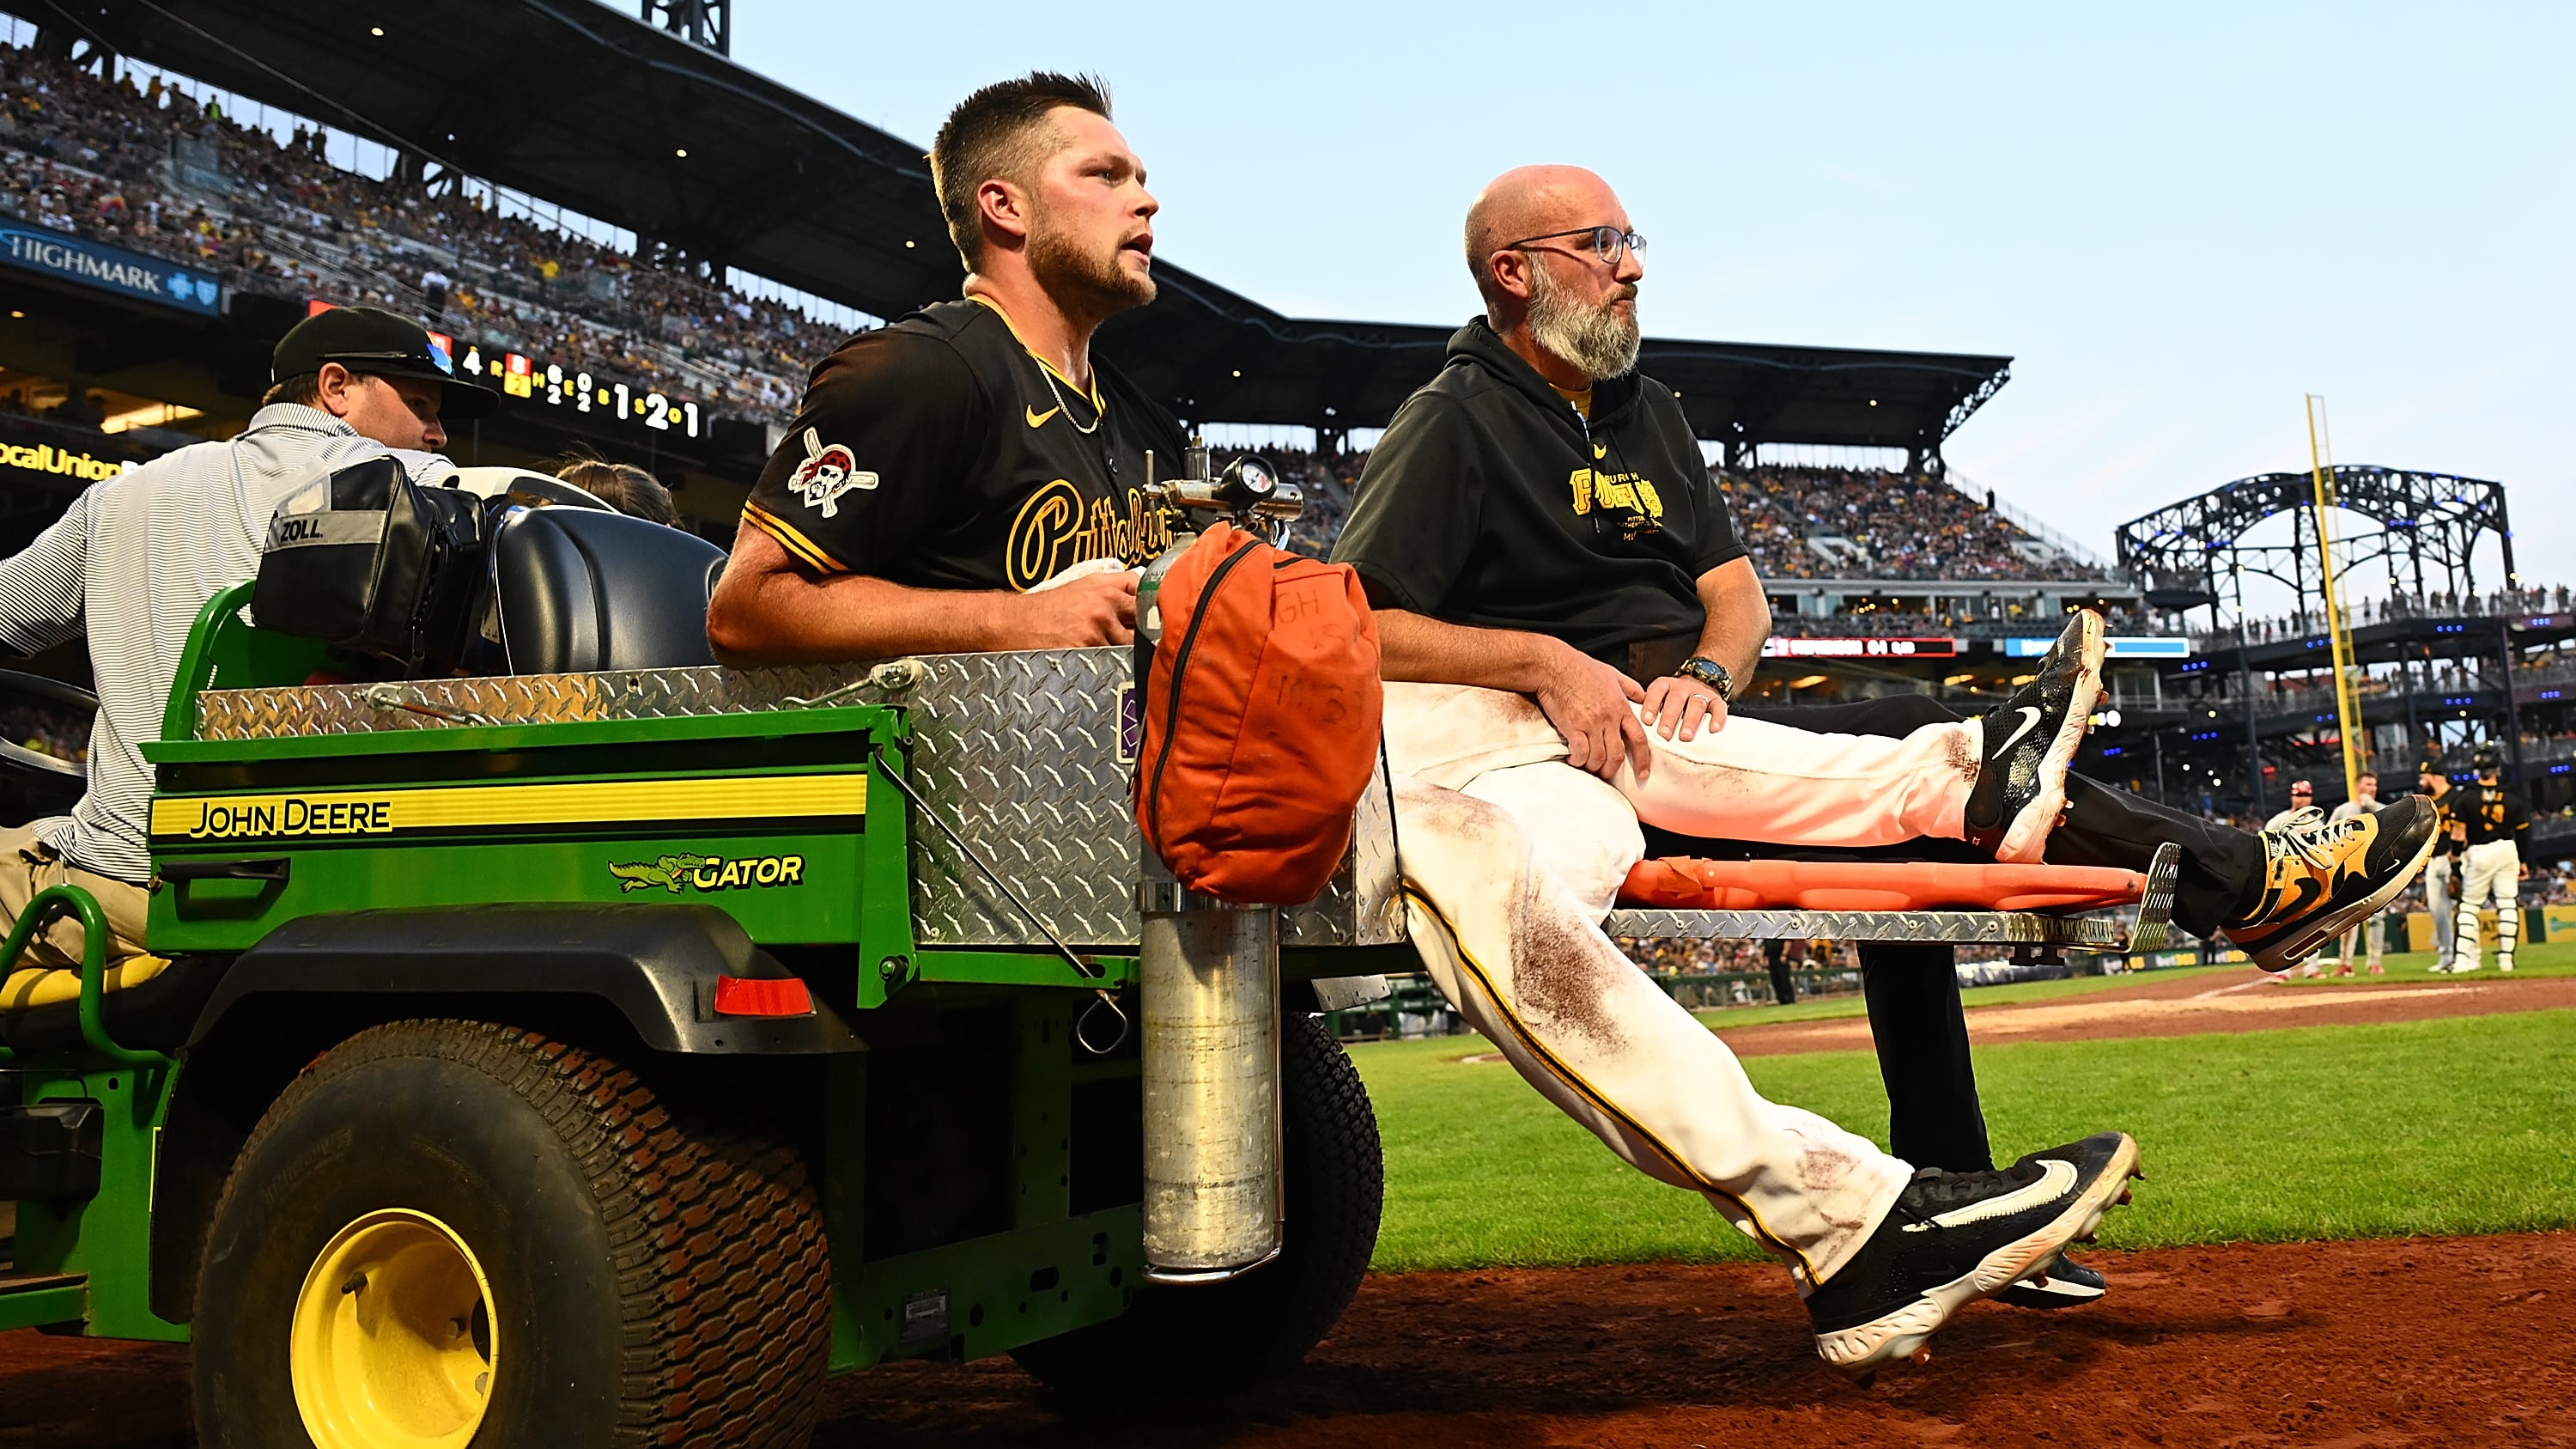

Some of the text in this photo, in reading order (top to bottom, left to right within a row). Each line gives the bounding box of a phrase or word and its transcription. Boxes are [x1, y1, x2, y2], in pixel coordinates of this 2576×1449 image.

[10, 234, 162, 295] HIGHMARK
[462, 350, 483, 376] 4
[490, 359, 504, 378] R
[532, 371, 546, 389] H
[563, 379, 574, 397] E
[577, 372, 592, 393] 0
[614, 383, 629, 420] 1
[634, 398, 647, 415] S
[645, 393, 669, 430] 2
[683, 402, 698, 438] 1
[547, 384, 562, 405] 2
[577, 392, 592, 412] 2
[190, 799, 392, 834] JOHN DEERE
[693, 855, 804, 889] GATOR
